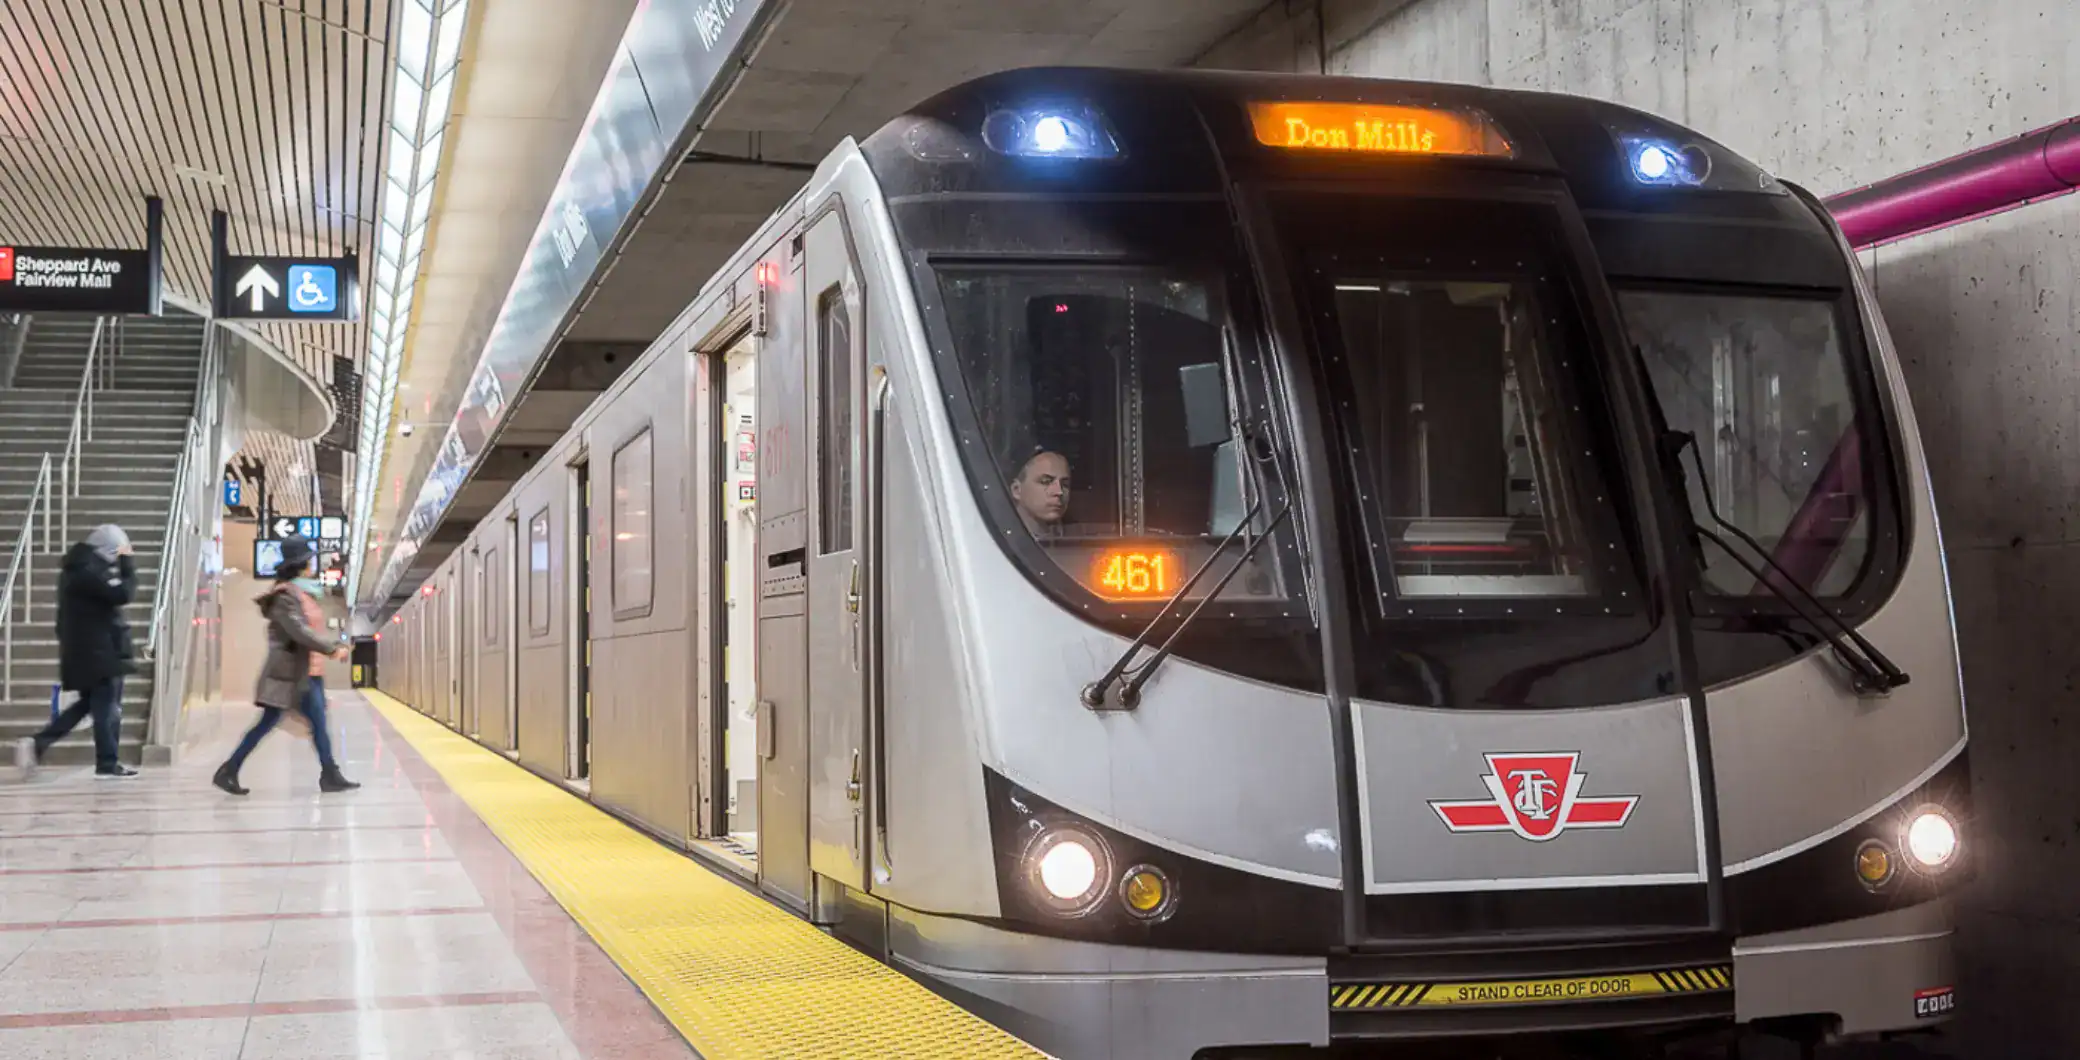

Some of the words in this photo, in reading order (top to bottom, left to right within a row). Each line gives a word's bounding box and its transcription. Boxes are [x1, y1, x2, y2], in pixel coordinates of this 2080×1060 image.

[692, 0, 726, 52] West
[1285, 117, 1349, 147] Don
[1354, 120, 1435, 151] Mills
[15, 256, 90, 273] Sheppard
[91, 257, 121, 273] Ave
[15, 271, 78, 287] Fairview
[79, 272, 112, 288] Mall
[1102, 552, 1165, 592] 461
[1458, 985, 1510, 1001] STAND
[1513, 982, 1563, 998] CLEAR
[1566, 981, 1587, 996] OF
[1589, 978, 1631, 994] DOOR
